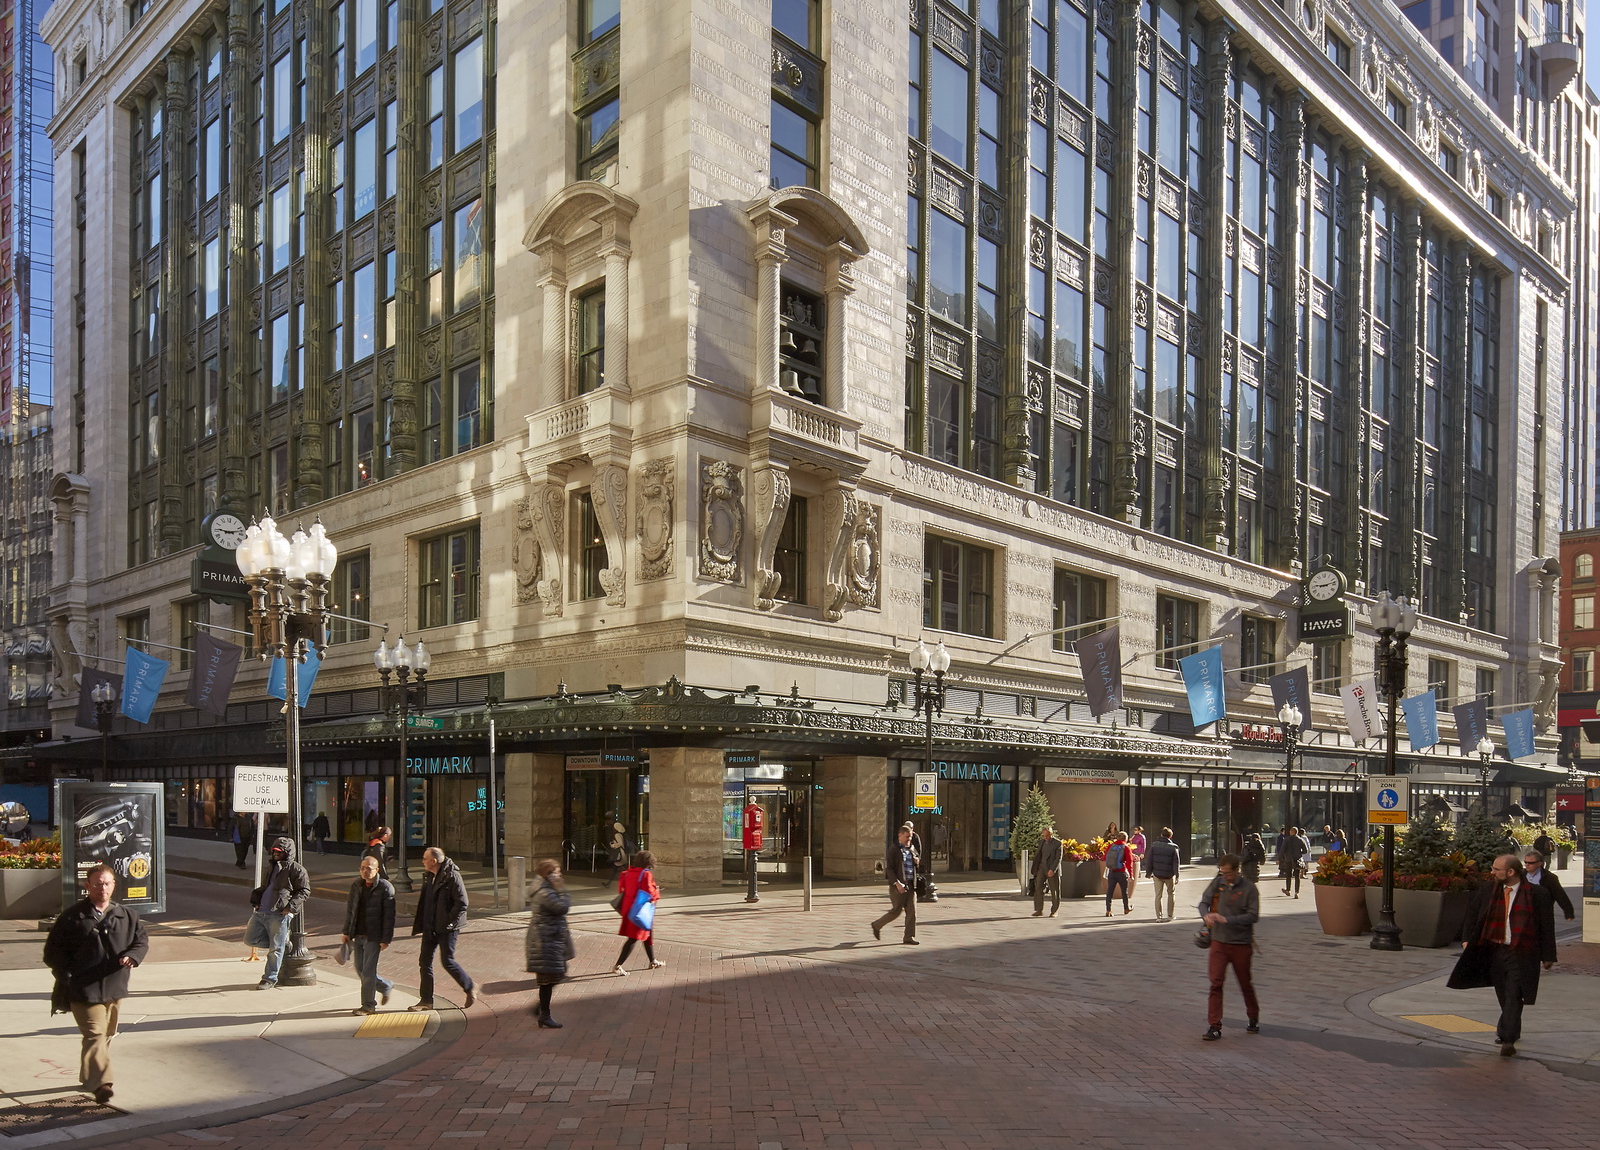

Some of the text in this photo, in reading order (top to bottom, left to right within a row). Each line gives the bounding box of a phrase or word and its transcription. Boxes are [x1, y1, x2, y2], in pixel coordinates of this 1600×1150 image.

[203, 571, 248, 584] PRIMAR
[1303, 618, 1342, 631] HAVAS
[200, 647, 222, 704] PRIMARK
[1094, 642, 1116, 703] PRIMARK
[127, 661, 150, 711] PRIMARK
[1198, 659, 1217, 716] PRIMARK
[1286, 678, 1299, 705] PRIM
[1357, 696, 1368, 720] Roche
[415, 718, 434, 727] SUMMER
[1416, 701, 1432, 742] PRIMARK
[1467, 707, 1480, 746] PRIMARK
[1241, 724, 1284, 742] Roche Bro
[1515, 717, 1528, 753] PRIMARK
[406, 756, 472, 773] PRIMARK
[605, 754, 635, 762] PRIMARK
[238, 773, 288, 783] PEDESTRIANS
[255, 786, 270, 794] USE
[244, 796, 281, 806] SIDEWALK
